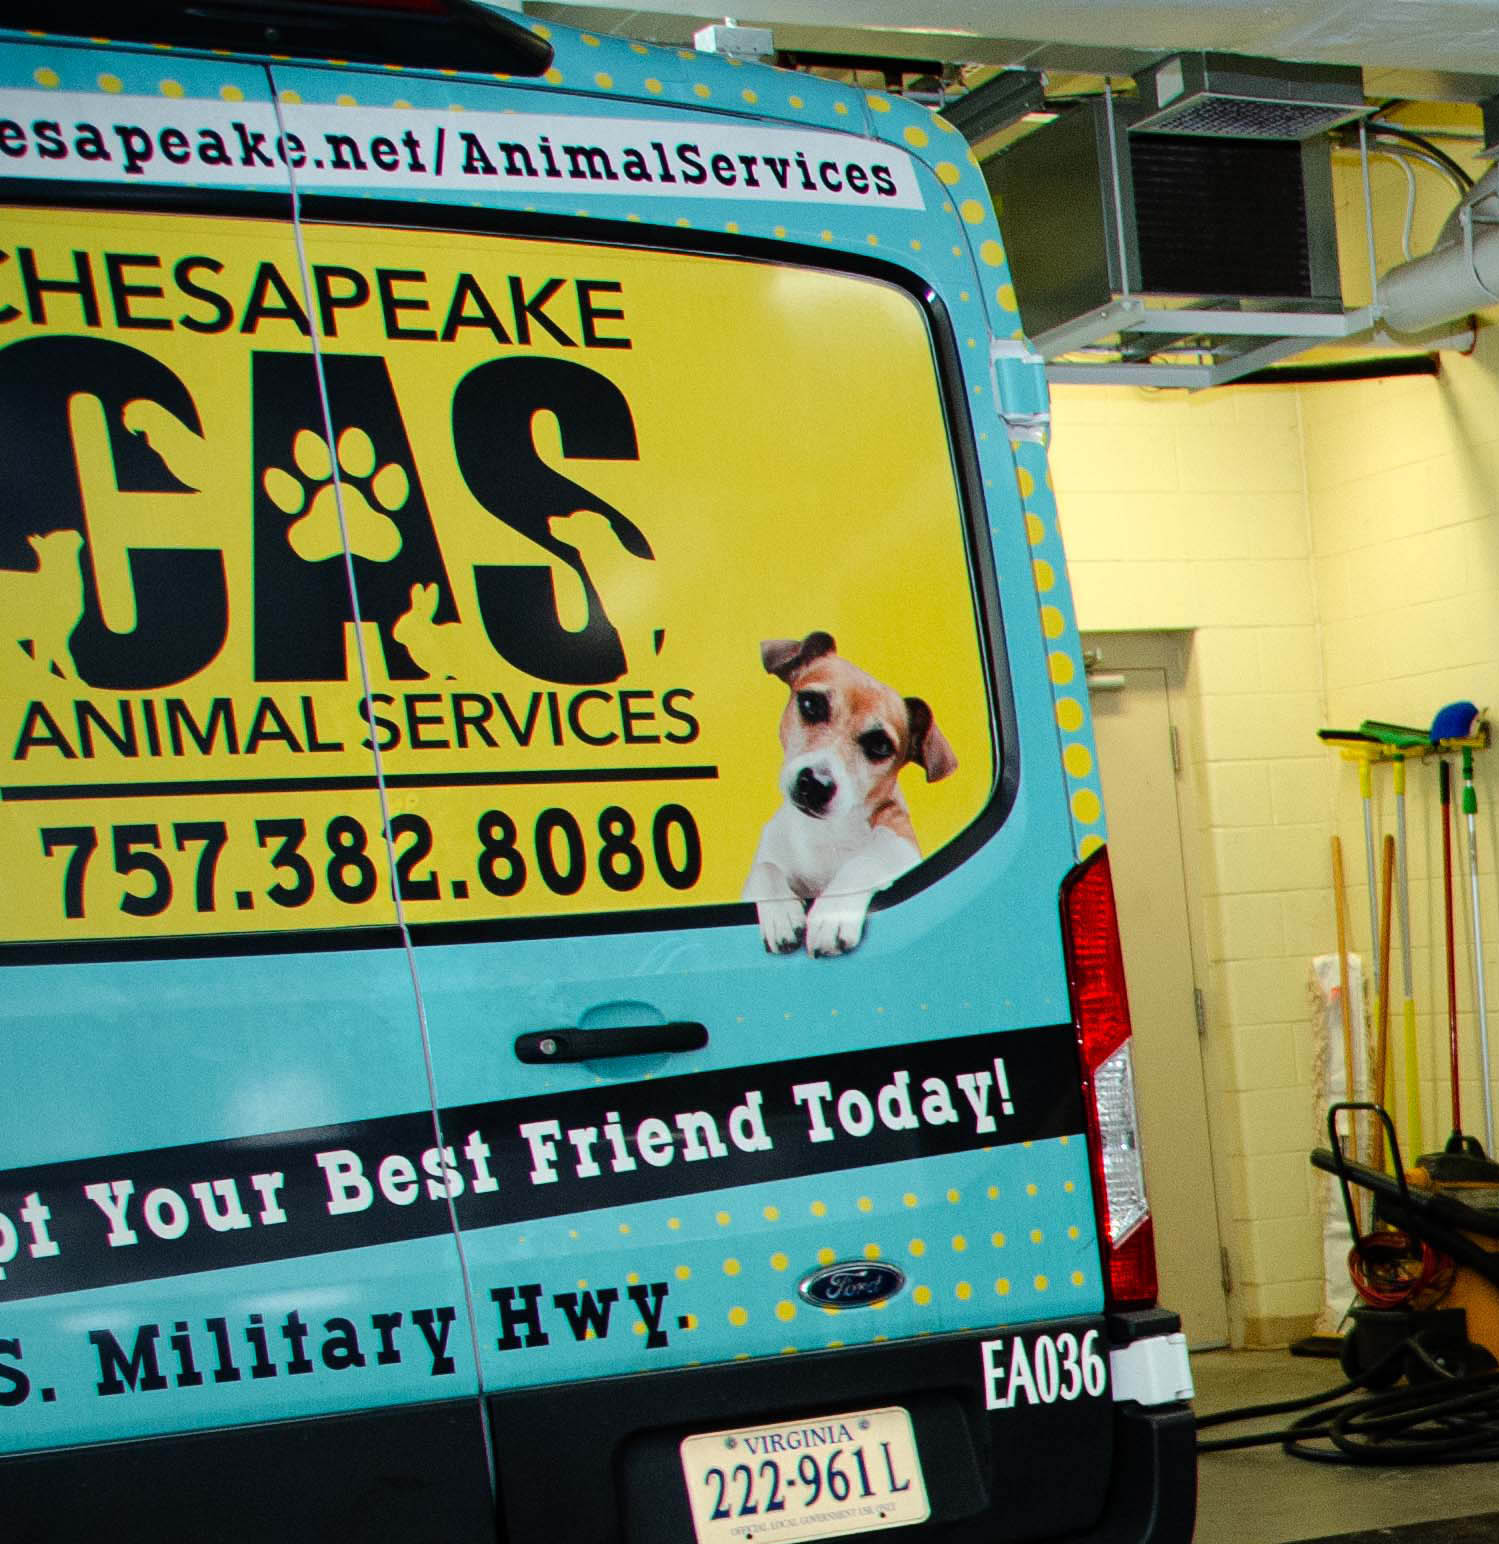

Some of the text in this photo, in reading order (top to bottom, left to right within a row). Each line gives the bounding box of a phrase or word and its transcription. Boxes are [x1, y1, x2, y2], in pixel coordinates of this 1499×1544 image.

[13, 689, 700, 760] ANIMAL SERVICES
[40, 803, 703, 920] 757.382.8080
[85, 1170, 289, 1248] Your
[315, 1129, 500, 1216] Best
[528, 1088, 768, 1187] Friend
[793, 1057, 1016, 1143] Today!
[825, 1268, 884, 1300] Ford
[89, 1307, 457, 1397] Military
[490, 1278, 690, 1352] Hwy.
[980, 1329, 1107, 1411] EA036
[742, 1422, 853, 1457] VIRGINIA
